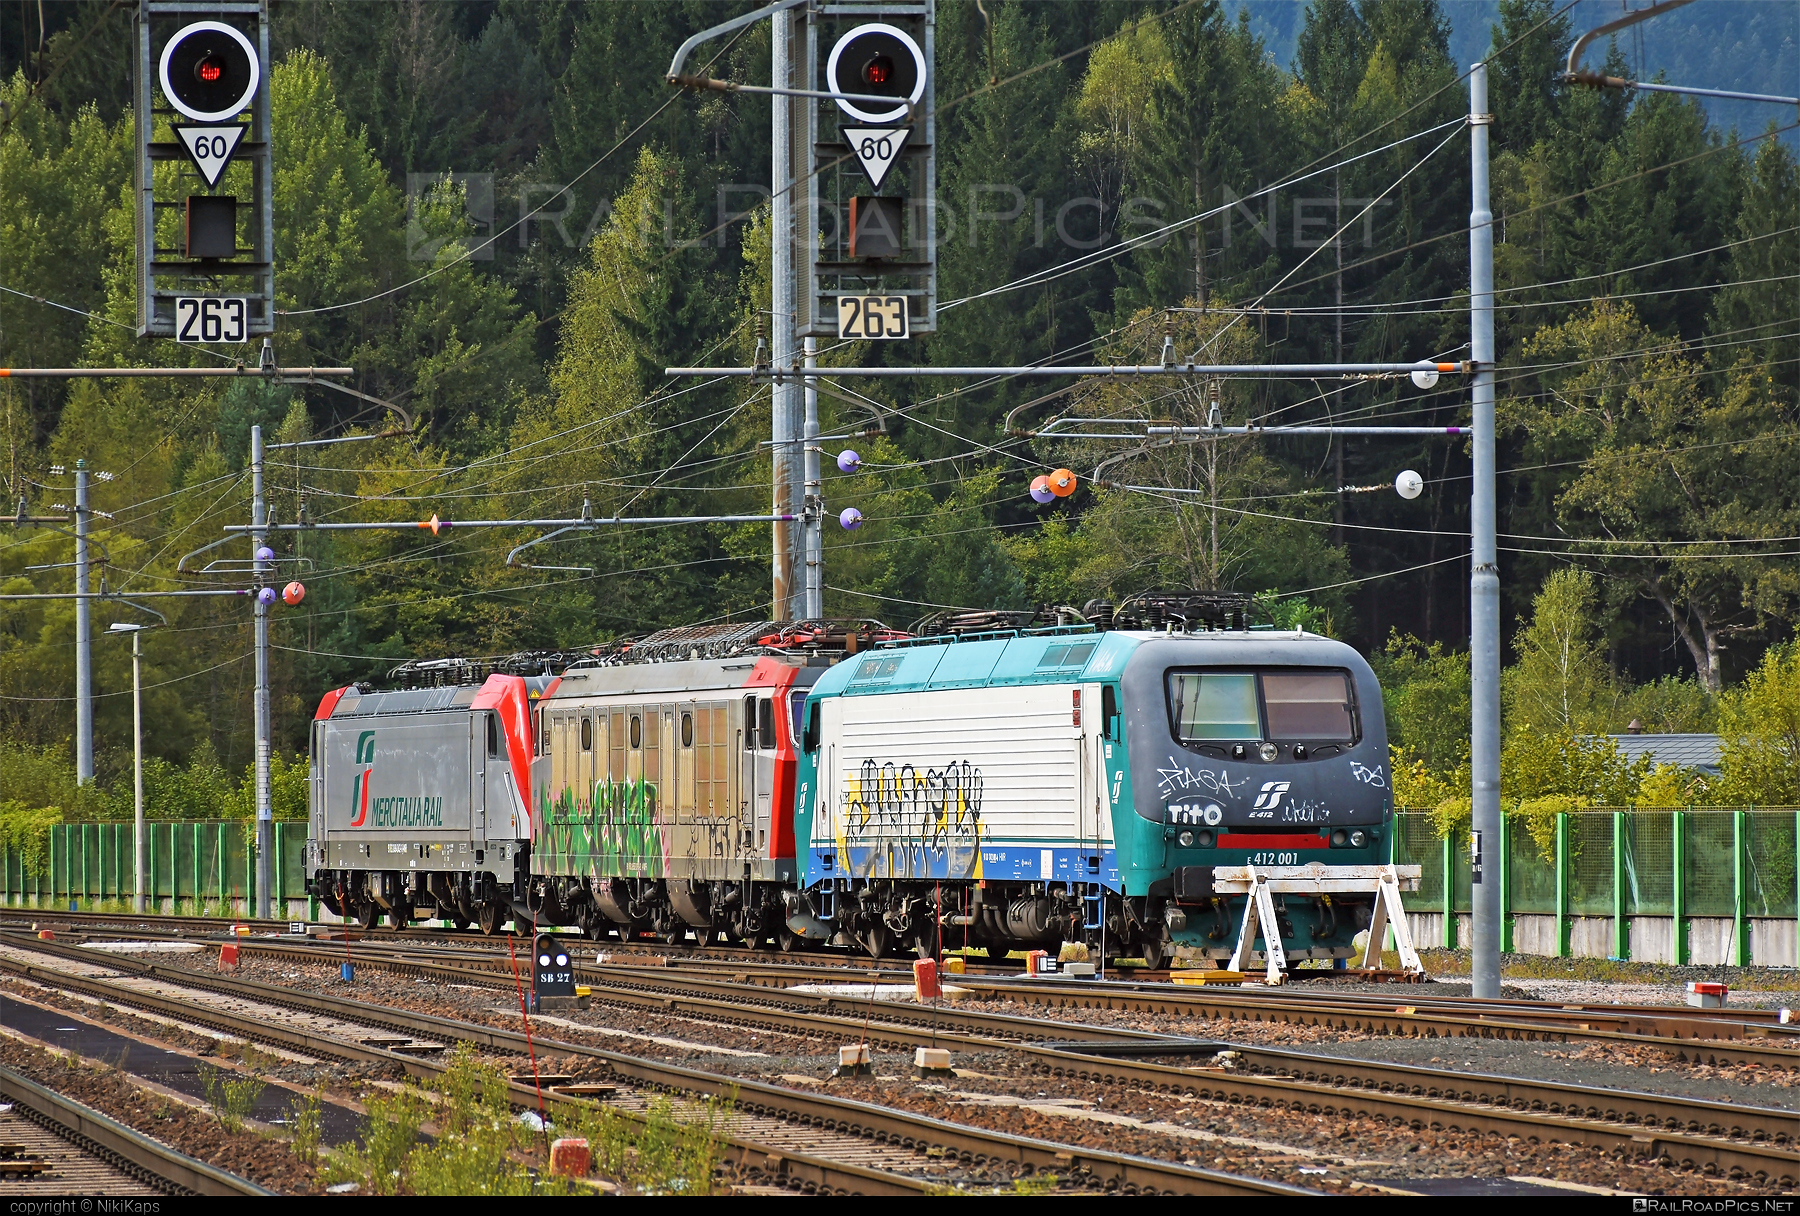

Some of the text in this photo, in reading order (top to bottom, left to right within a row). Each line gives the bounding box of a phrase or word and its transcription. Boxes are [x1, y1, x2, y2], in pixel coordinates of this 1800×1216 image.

[195, 135, 227, 159] 60
[860, 137, 892, 160] 60
[179, 299, 244, 342] 263
[841, 297, 906, 338] 263
[371, 796, 443, 828] MERCITALIA RAIL
[1247, 852, 1298, 865] E 412 001
[540, 972, 570, 983] SB 27
